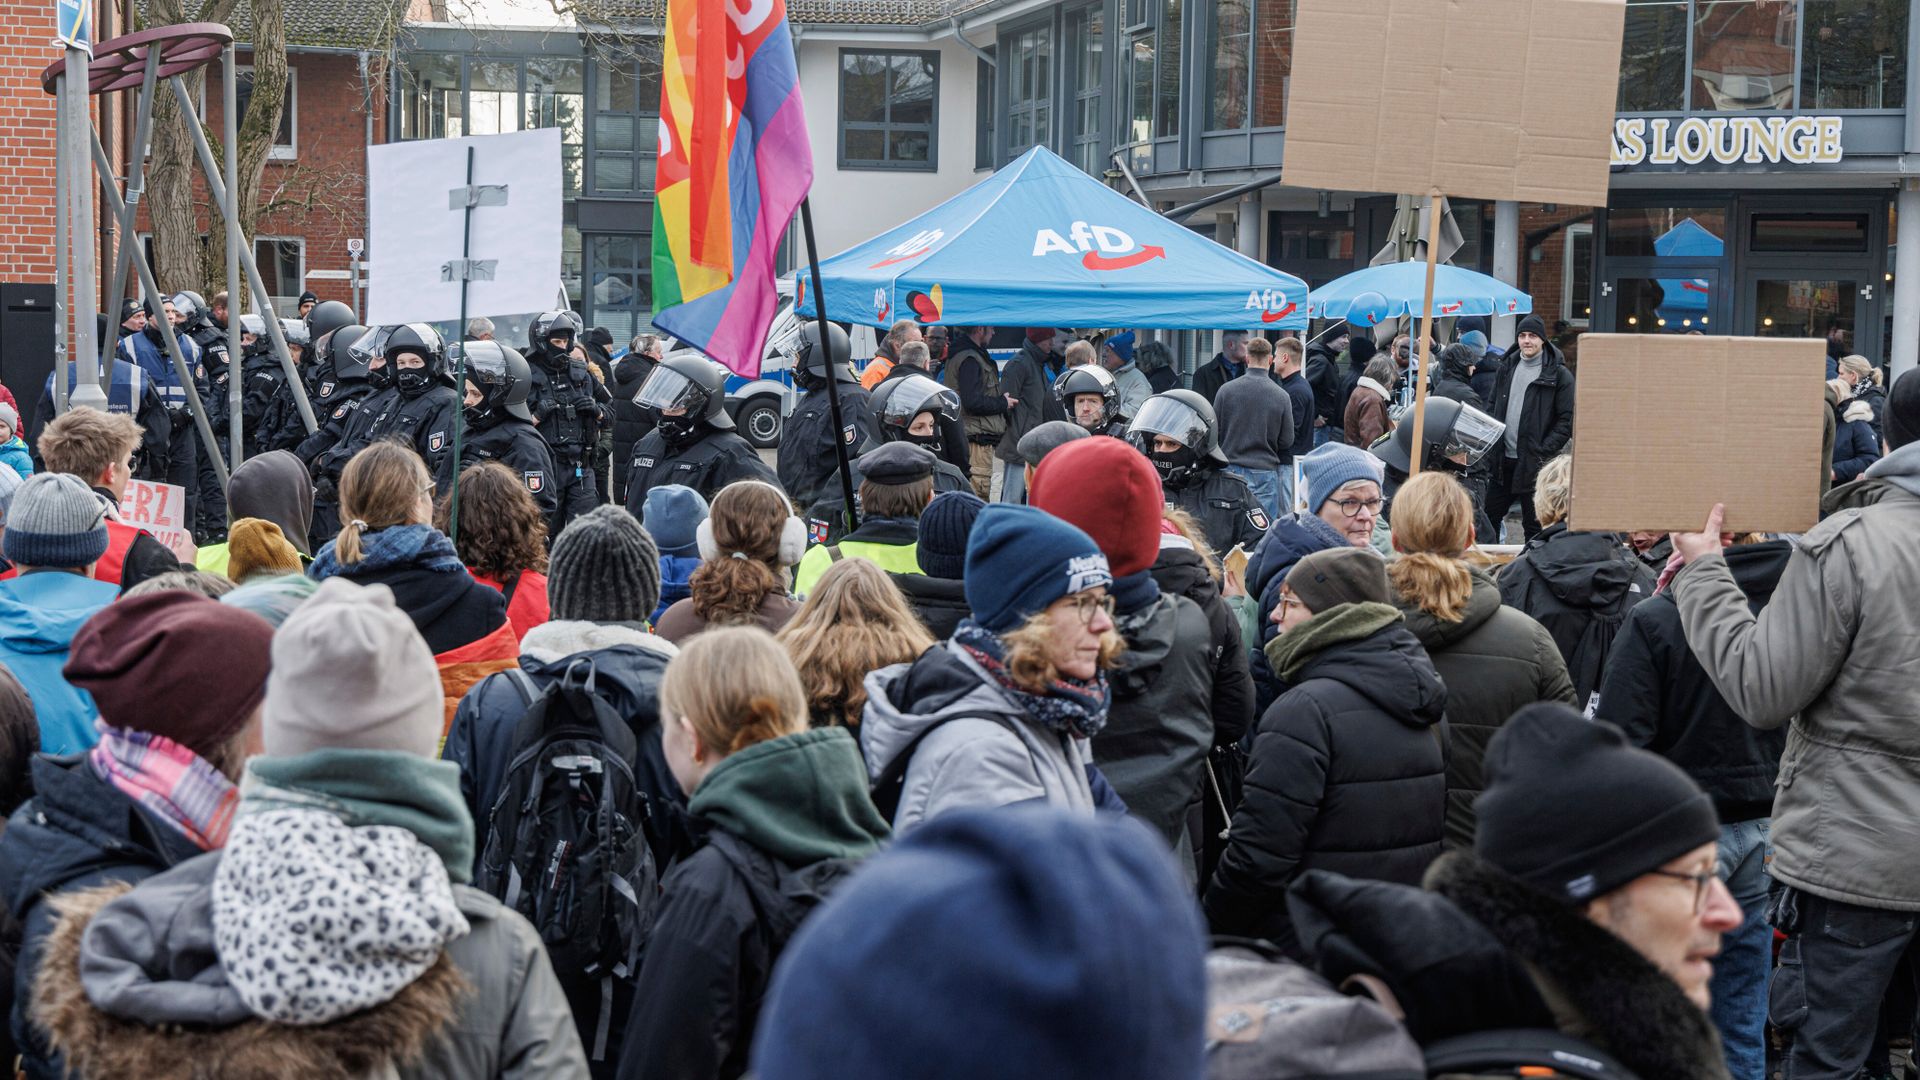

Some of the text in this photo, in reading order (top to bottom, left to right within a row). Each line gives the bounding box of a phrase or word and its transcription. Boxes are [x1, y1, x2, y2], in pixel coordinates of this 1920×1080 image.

[1650, 117, 1843, 164] LOUNGE
[1032, 220, 1135, 256] AfD
[1245, 288, 1287, 310] AfD
